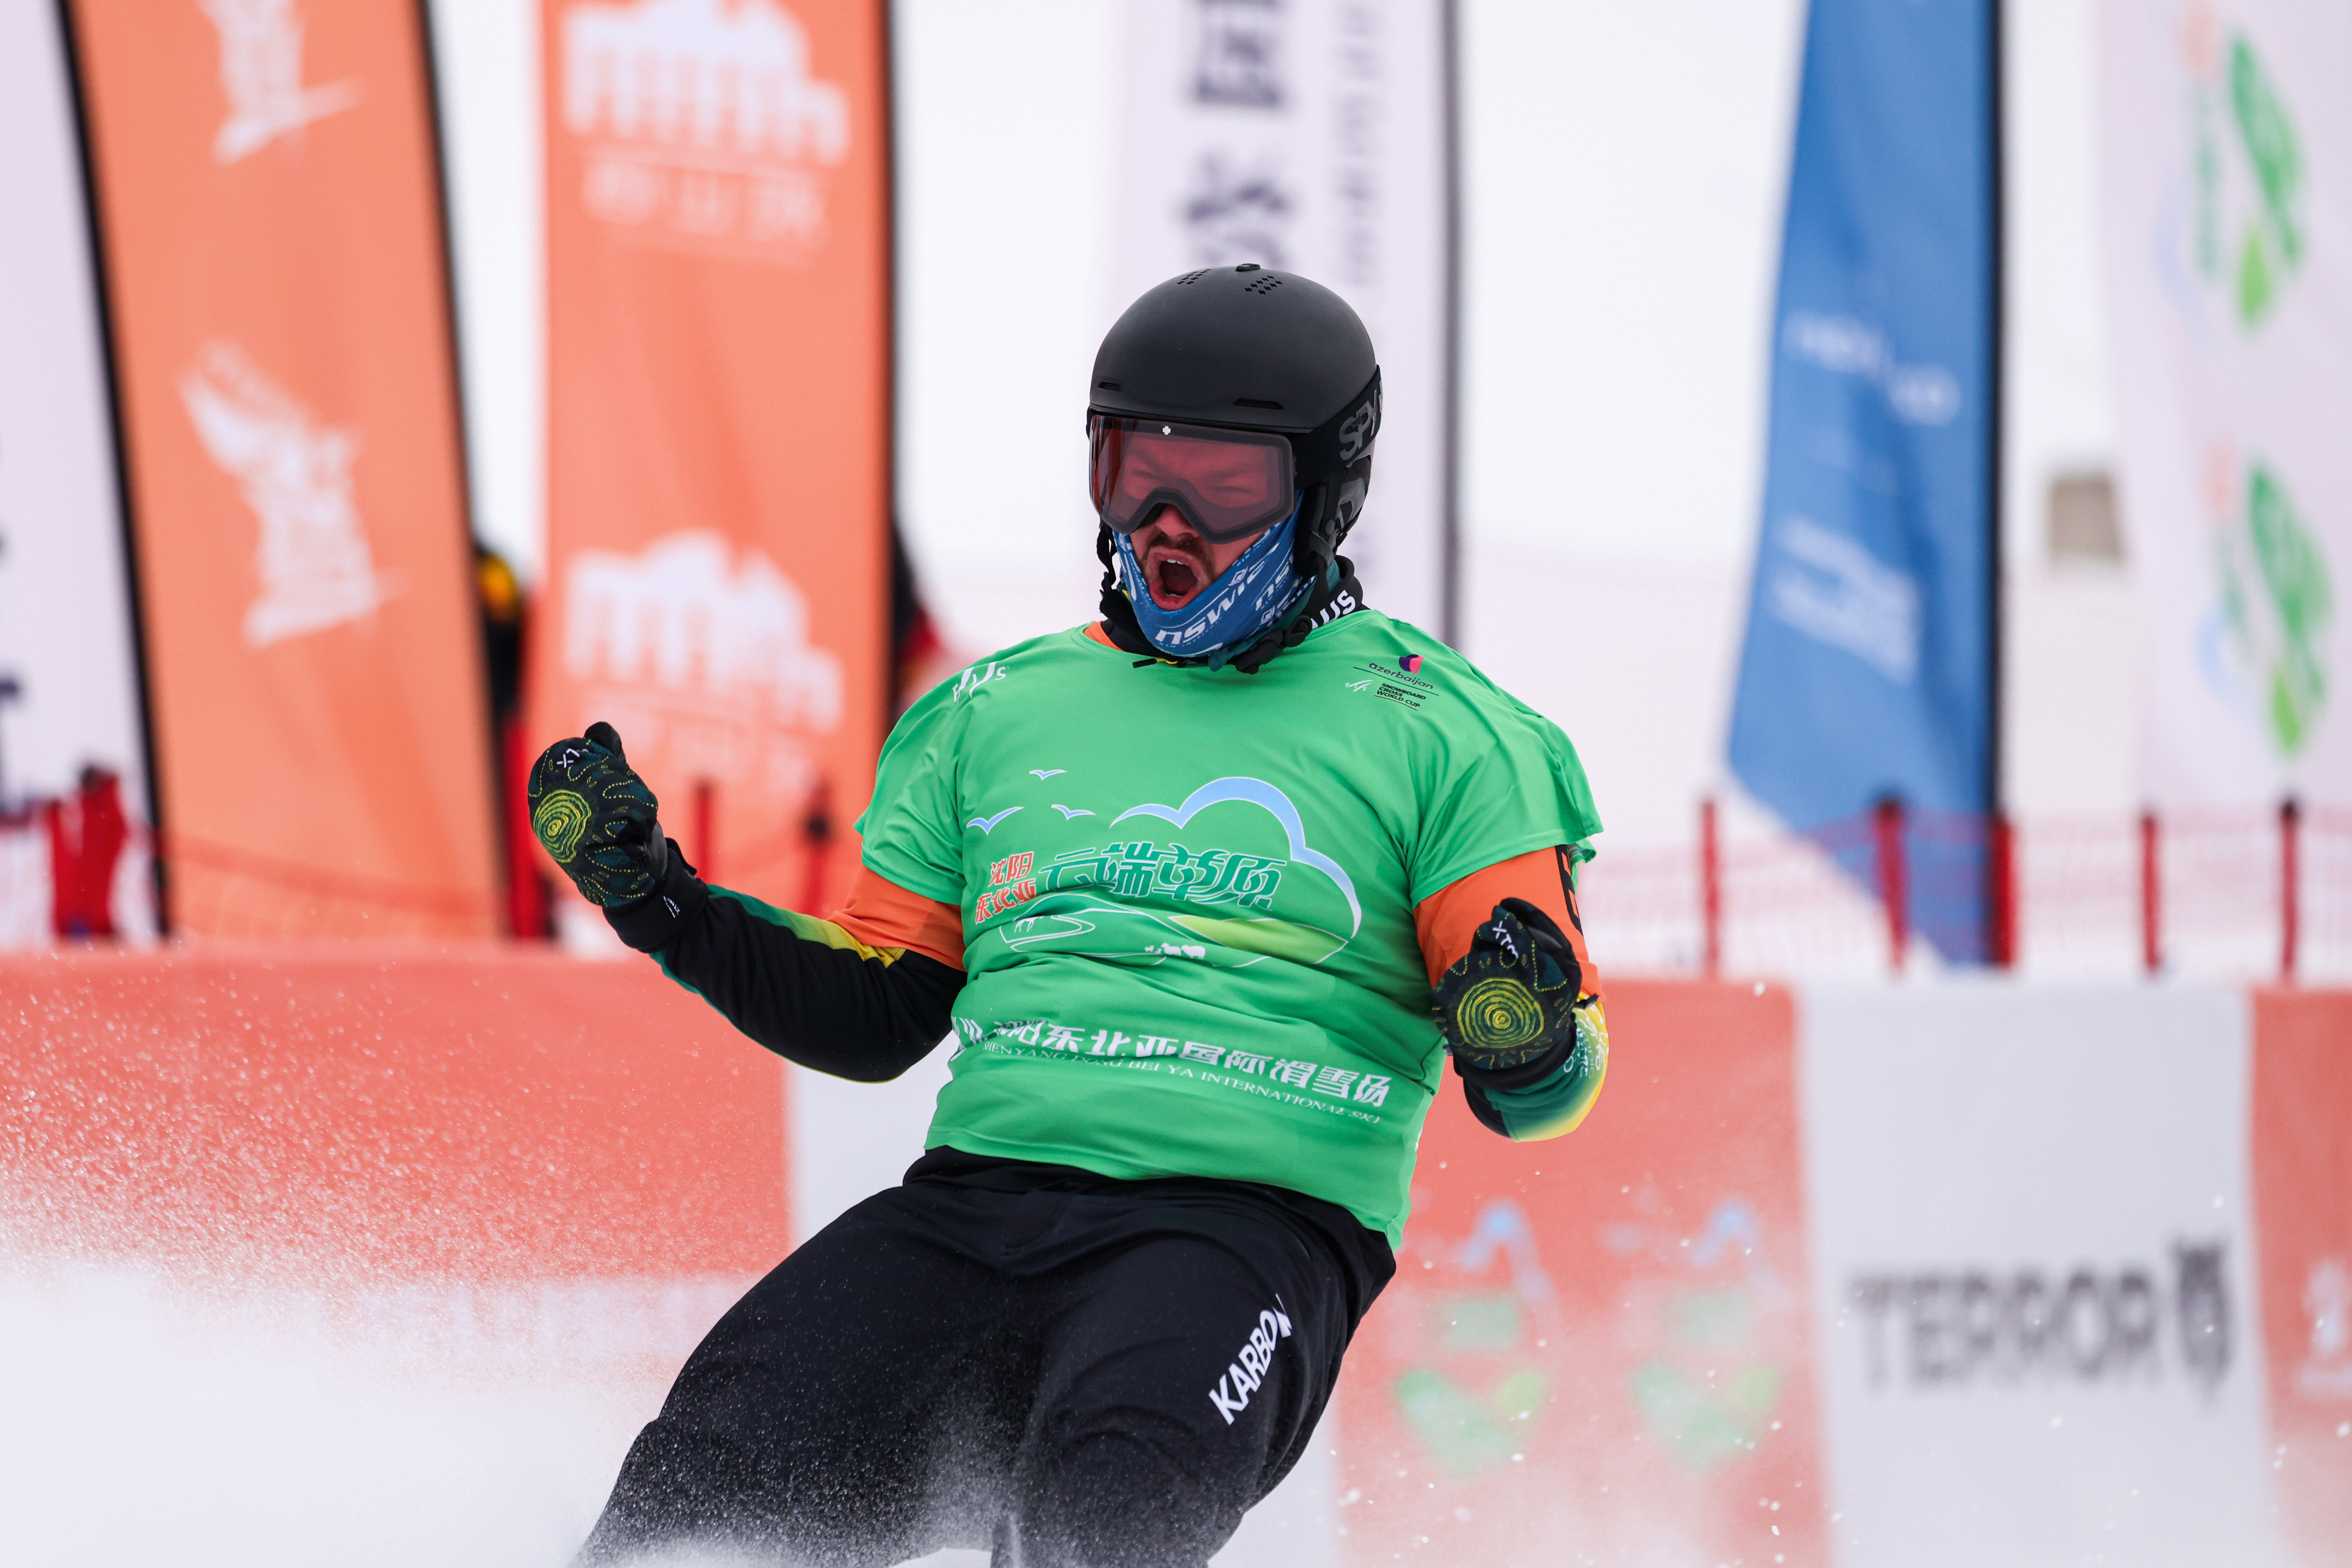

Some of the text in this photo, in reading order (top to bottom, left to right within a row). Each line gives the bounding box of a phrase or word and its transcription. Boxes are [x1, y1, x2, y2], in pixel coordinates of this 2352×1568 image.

[1339, 388, 1377, 460] SPY
[1310, 590, 1356, 629] US
[1369, 663, 1434, 689] azerbaijan
[1379, 687, 1403, 697] CROSS
[1382, 683, 1426, 700] SNOWBOARD
[1377, 690, 1404, 701] WORLD
[988, 851, 1035, 888] 沈阳
[975, 877, 1041, 925] 东北亚
[982, 1041, 1066, 1061] SHENYANG
[1072, 1055, 1122, 1067] DONG
[1128, 1059, 1160, 1072] BEI
[1168, 1064, 1193, 1078] YA
[1201, 1072, 1344, 1115] INTERNATIONAL
